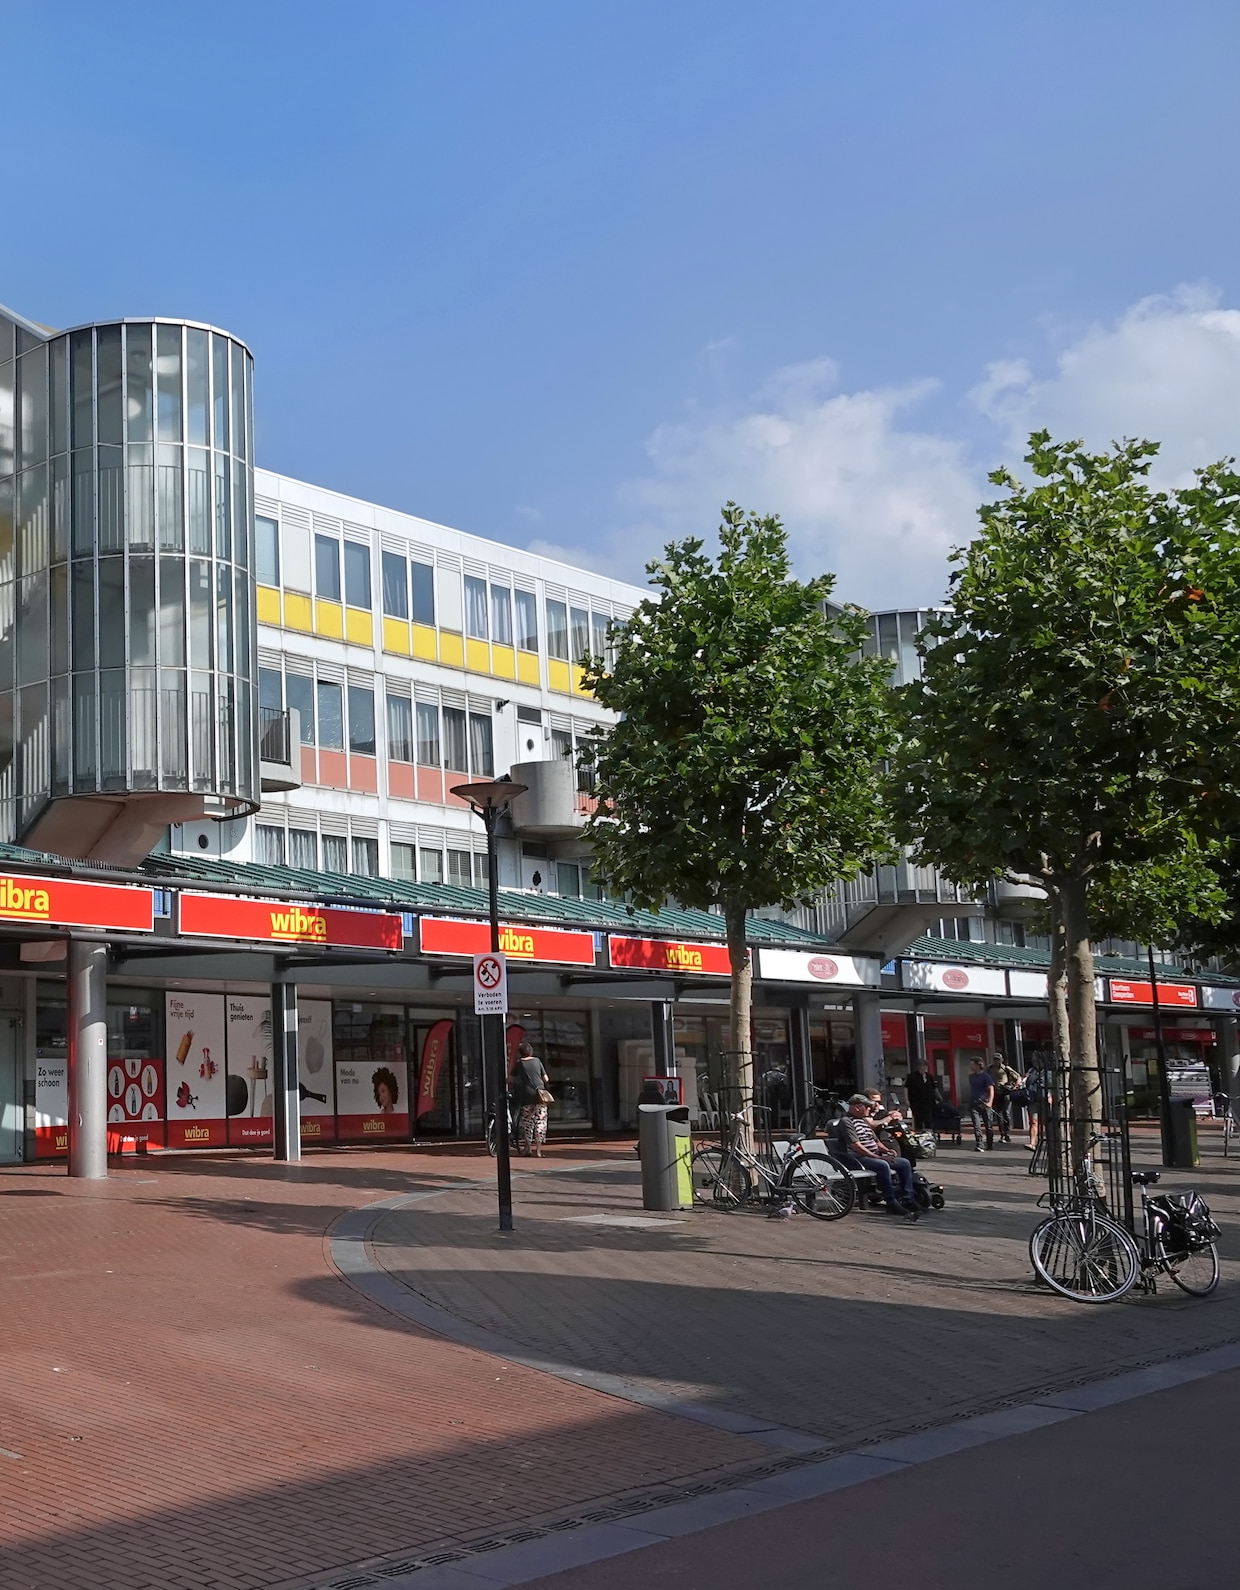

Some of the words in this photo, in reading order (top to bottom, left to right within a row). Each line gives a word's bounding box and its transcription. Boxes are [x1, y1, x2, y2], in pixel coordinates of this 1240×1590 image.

[270, 908, 327, 935] wibra
[665, 945, 702, 966] wibra
[170, 1000, 184, 1010] Fijne
[230, 1003, 244, 1012] Thuis
[170, 1010, 184, 1019] vrije
[184, 1009, 195, 1020] tijd
[230, 1012, 254, 1022] genieten
[38, 1067, 46, 1077] Zo
[48, 1068, 64, 1076] weer
[340, 1069, 355, 1077] Mode
[422, 1039, 439, 1096] wibra
[38, 1079, 60, 1088] schoon
[300, 1122, 321, 1134] wibra
[363, 1120, 386, 1131] wibra
[185, 1126, 210, 1138] wibra
